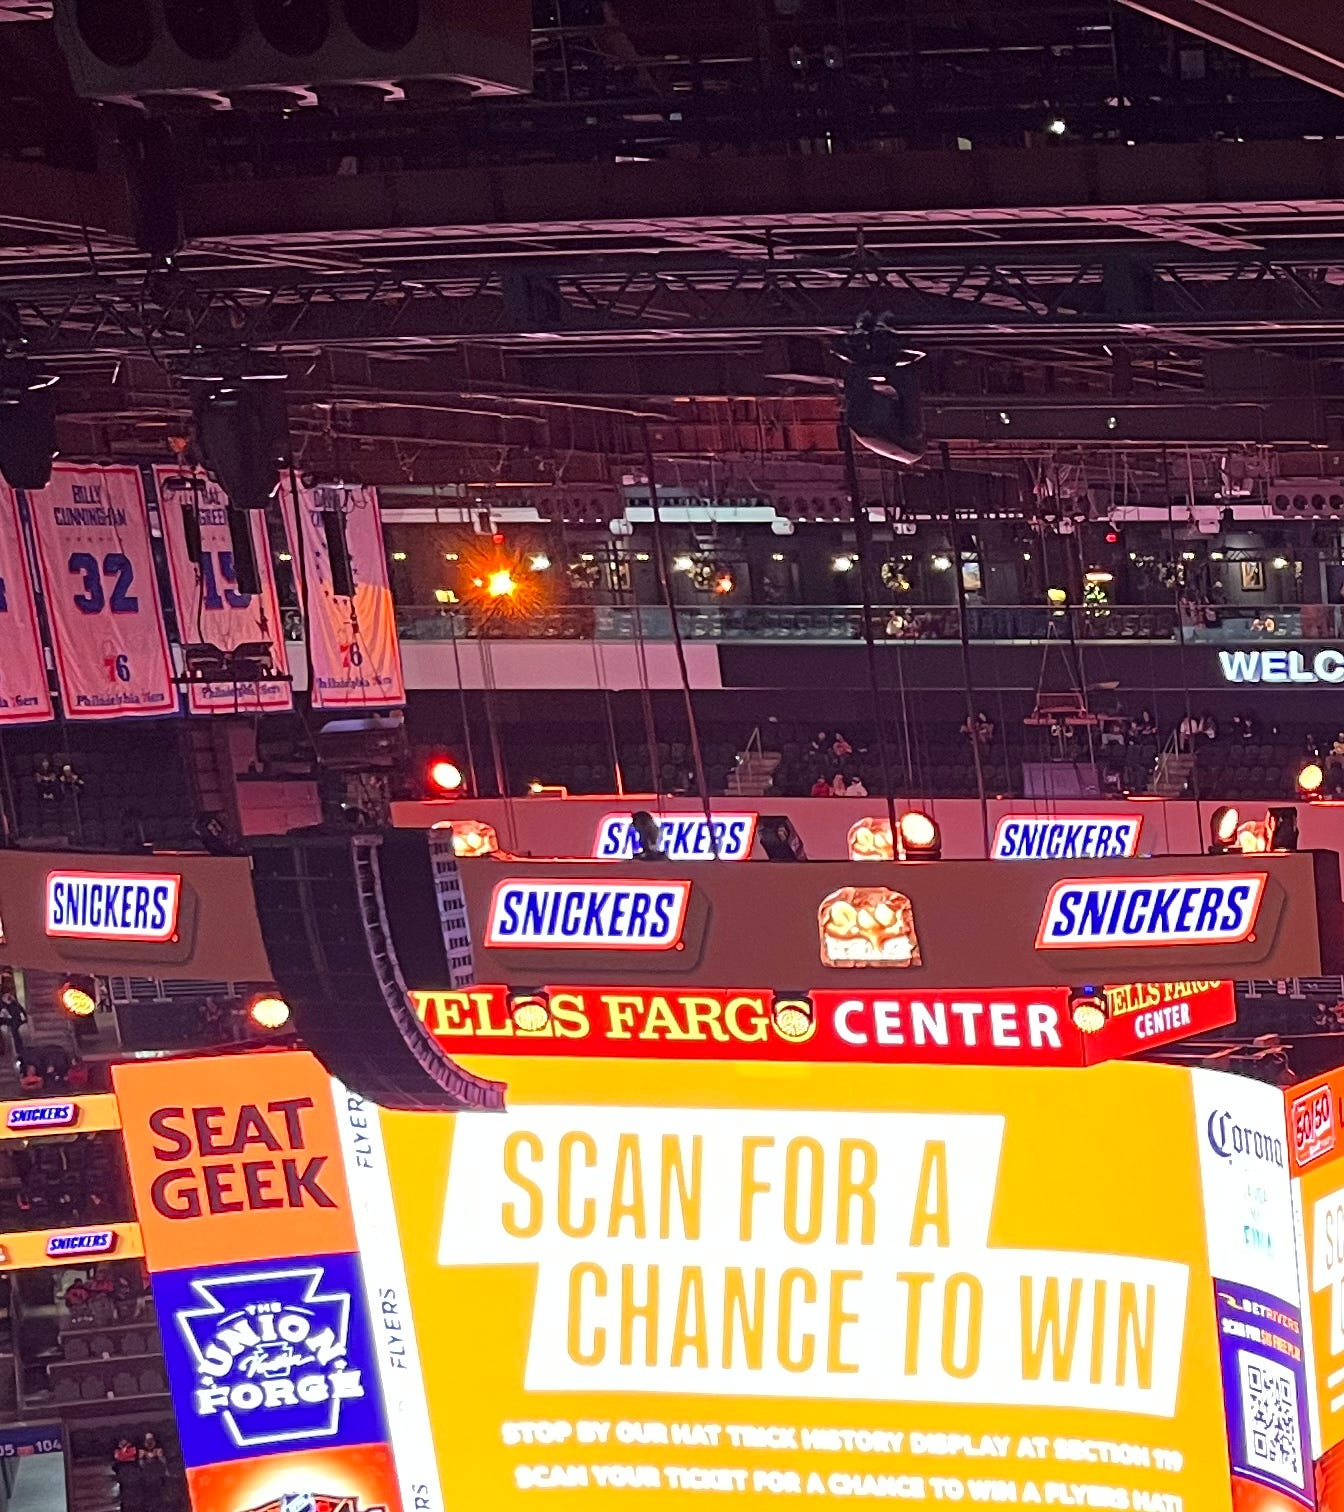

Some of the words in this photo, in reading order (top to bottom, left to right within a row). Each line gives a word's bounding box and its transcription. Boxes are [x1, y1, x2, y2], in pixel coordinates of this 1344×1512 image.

[68, 552, 139, 614] 32
[104, 654, 131, 683] 76
[602, 821, 746, 857] SNCKERS
[999, 823, 1132, 858] SNICKERS
[53, 881, 169, 930] SNICKERS
[498, 889, 677, 937] SNICKERS
[1051, 885, 1251, 938] SNICKERS
[833, 1000, 1063, 1050] CENTER
[1134, 1002, 1192, 1039] CENTER
[11, 1105, 70, 1123] SNICKERS
[148, 1096, 315, 1162] SEAT
[347, 1097, 374, 1169] FLYER
[1207, 1109, 1284, 1168] Corona
[150, 1154, 339, 1221] GEEK
[501, 1129, 704, 1242] SCAN
[738, 1134, 879, 1246] FOR
[909, 1138, 951, 1249] A
[245, 1302, 282, 1316] THE
[379, 1287, 409, 1370] FLYERS
[566, 1260, 862, 1376] CHANCE
[894, 1271, 985, 1381] TO
[1018, 1275, 1157, 1392] WIN
[199, 1313, 347, 1378] UNION
[196, 1370, 365, 1416] FORGE
[35, 1439, 62, 1453] 104
[501, 1421, 572, 1446] STOP
[576, 1421, 611, 1444] BY
[615, 1422, 668, 1445] OUR
[671, 1423, 722, 1446] HAT
[726, 1424, 798, 1449] TRICK
[800, 1427, 904, 1454] HISTORY
[909, 1431, 1011, 1458] DISPLAY
[1016, 1435, 1050, 1459] AT
[1053, 1438, 1151, 1468] SECTION
[514, 1463, 589, 1490] SCAN
[590, 1463, 661, 1489] YOUR
[663, 1466, 749, 1491] TICKET
[752, 1469, 803, 1494] FOR
[805, 1471, 827, 1495] A
[827, 1471, 926, 1499] CHANCE
[928, 1476, 965, 1501] TO
[967, 1477, 1018, 1503] WIN
[1022, 1480, 1042, 1504] A
[1044, 1481, 1131, 1510] FLYERS
